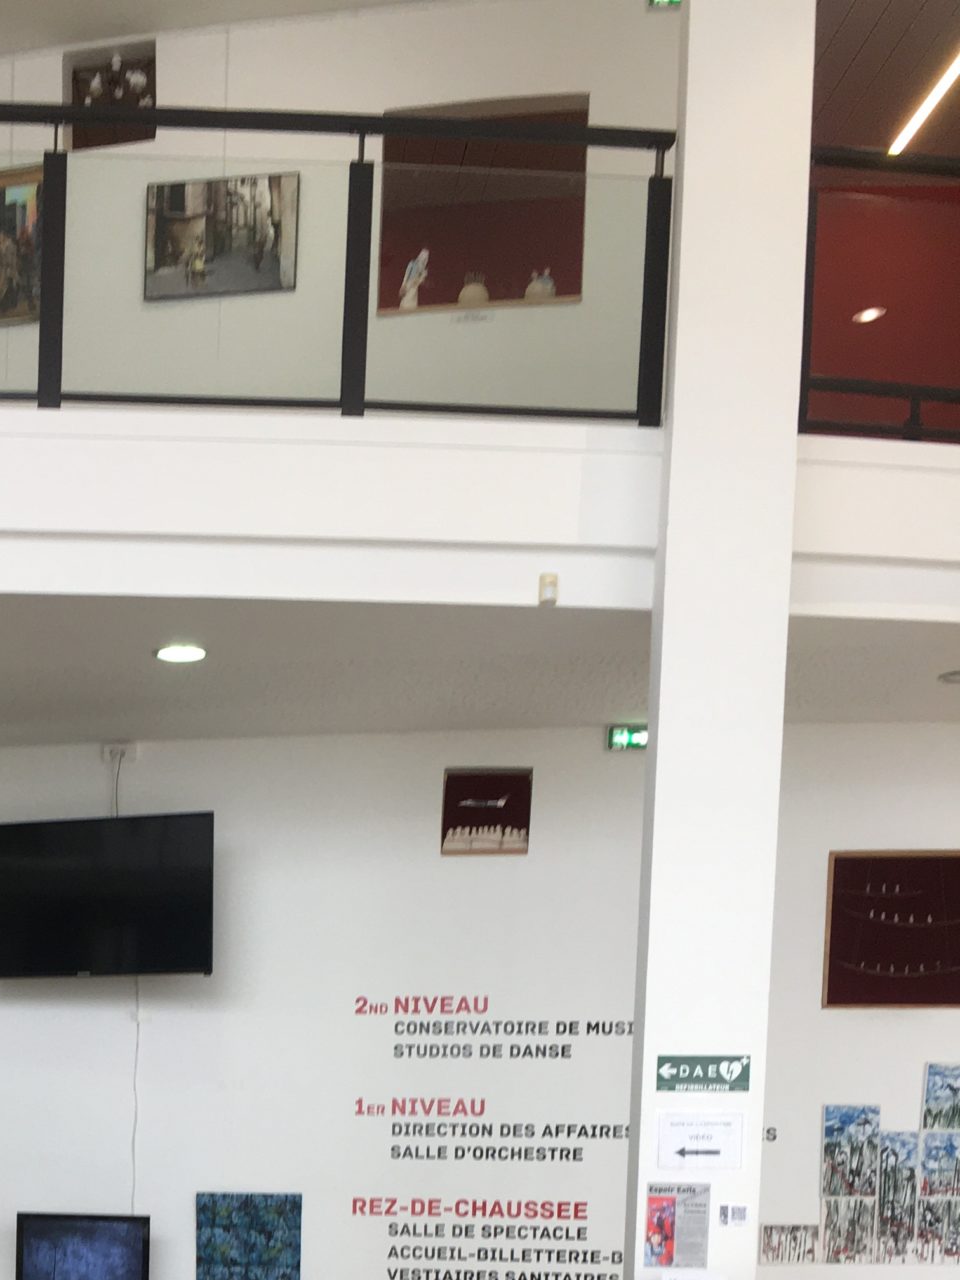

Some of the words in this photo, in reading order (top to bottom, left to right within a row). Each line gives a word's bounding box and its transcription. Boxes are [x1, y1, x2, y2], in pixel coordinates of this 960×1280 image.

[355, 996, 388, 1015] 2ND
[393, 996, 488, 1014] NIVEAU
[395, 1021, 548, 1035] CONSERVATOIRE
[555, 1021, 579, 1035] DE
[394, 1044, 472, 1058] STUDIOS
[480, 1044, 502, 1058] DE
[510, 1044, 573, 1059] DANSE
[679, 1064, 717, 1078] DAE
[355, 1098, 385, 1116] 1ER
[392, 1098, 485, 1116] NIVEAU
[392, 1122, 493, 1138] DIRECTION
[500, 1123, 535, 1138] DES
[391, 1145, 447, 1160] SALLE
[455, 1146, 583, 1161] D'ORCHESTRE
[352, 1197, 588, 1222] REZ-DE-CHAUSSEE
[389, 1222, 445, 1238] SALLE
[452, 1224, 475, 1239] DE
[481, 1224, 587, 1241] SPECTACLE
